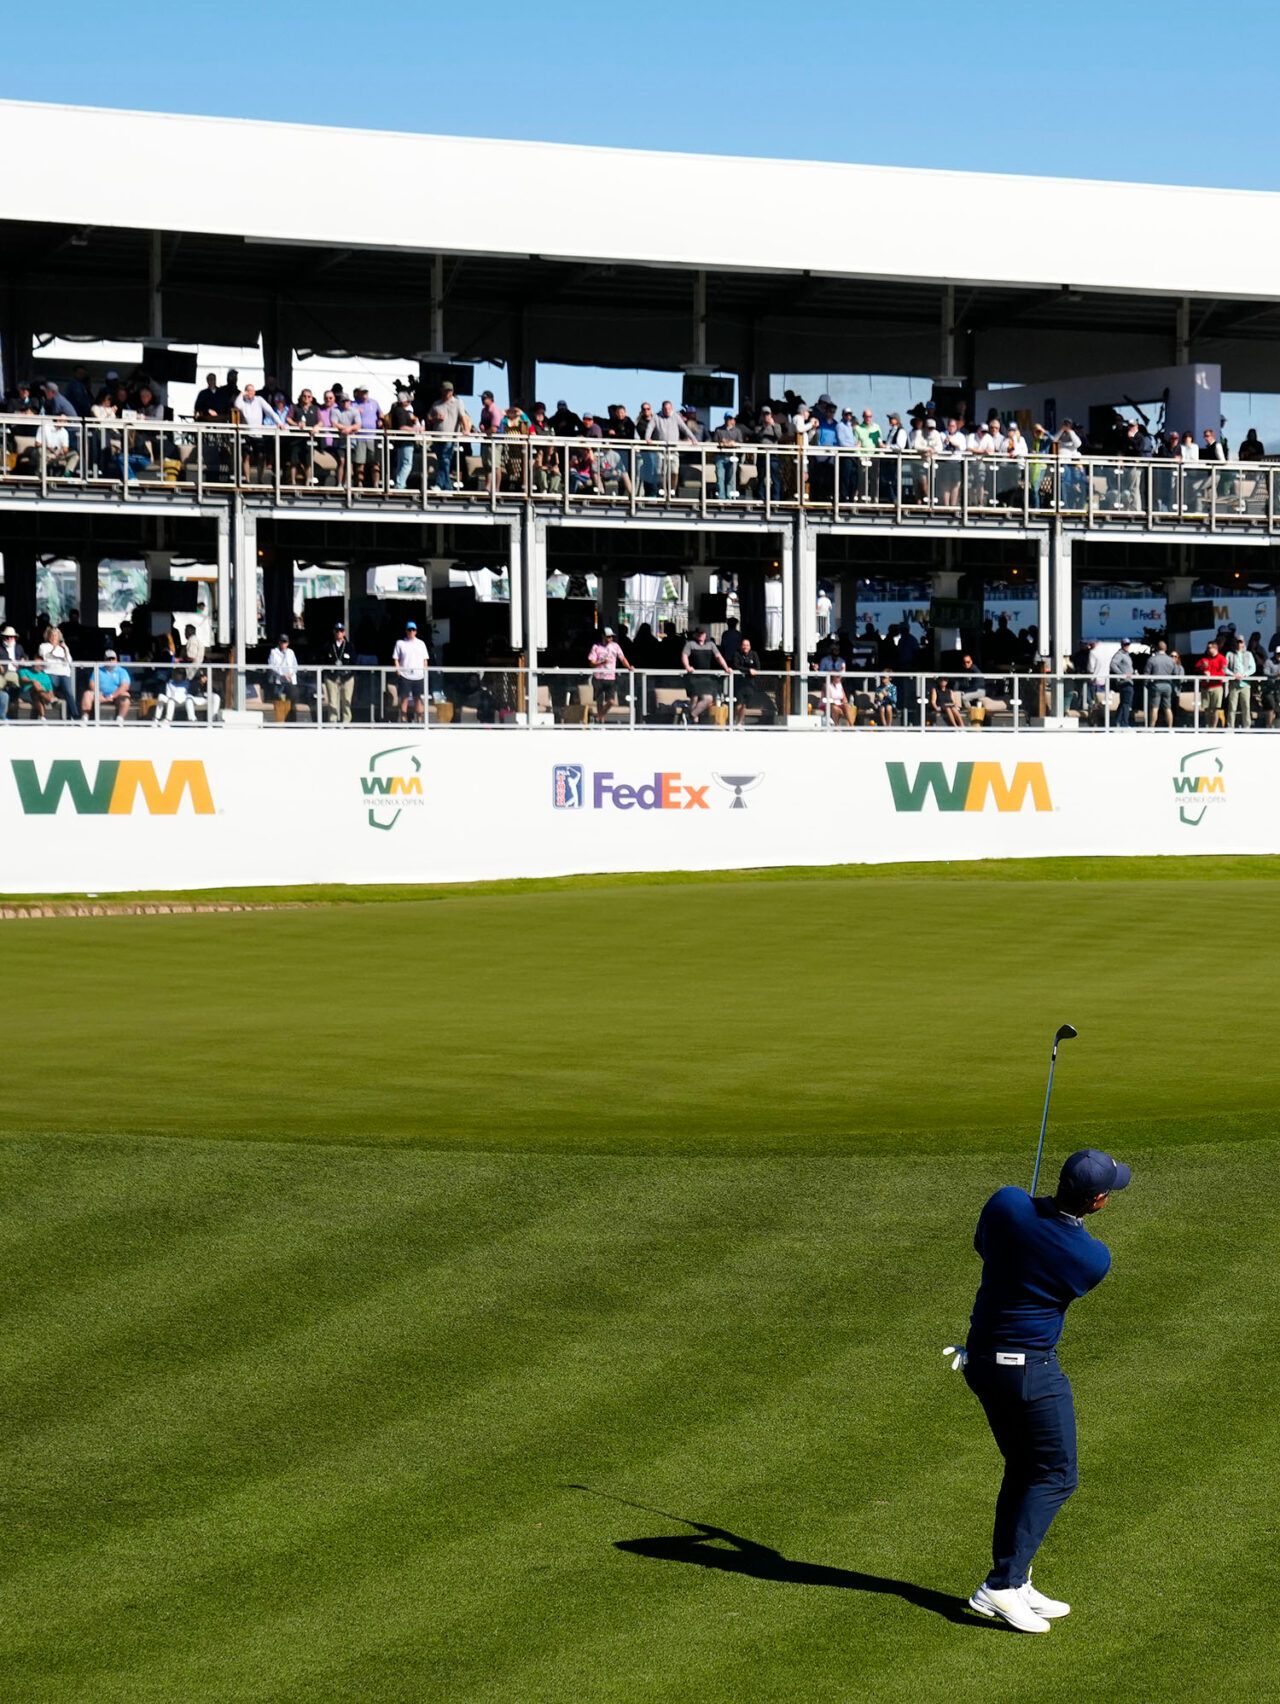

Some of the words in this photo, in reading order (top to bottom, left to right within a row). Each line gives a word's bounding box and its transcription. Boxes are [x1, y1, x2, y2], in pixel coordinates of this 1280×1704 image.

[10, 759, 216, 815] WM
[360, 777, 423, 795] WM
[593, 772, 710, 810] FedEx
[885, 761, 1053, 812] WM
[1172, 776, 1225, 793] WM
